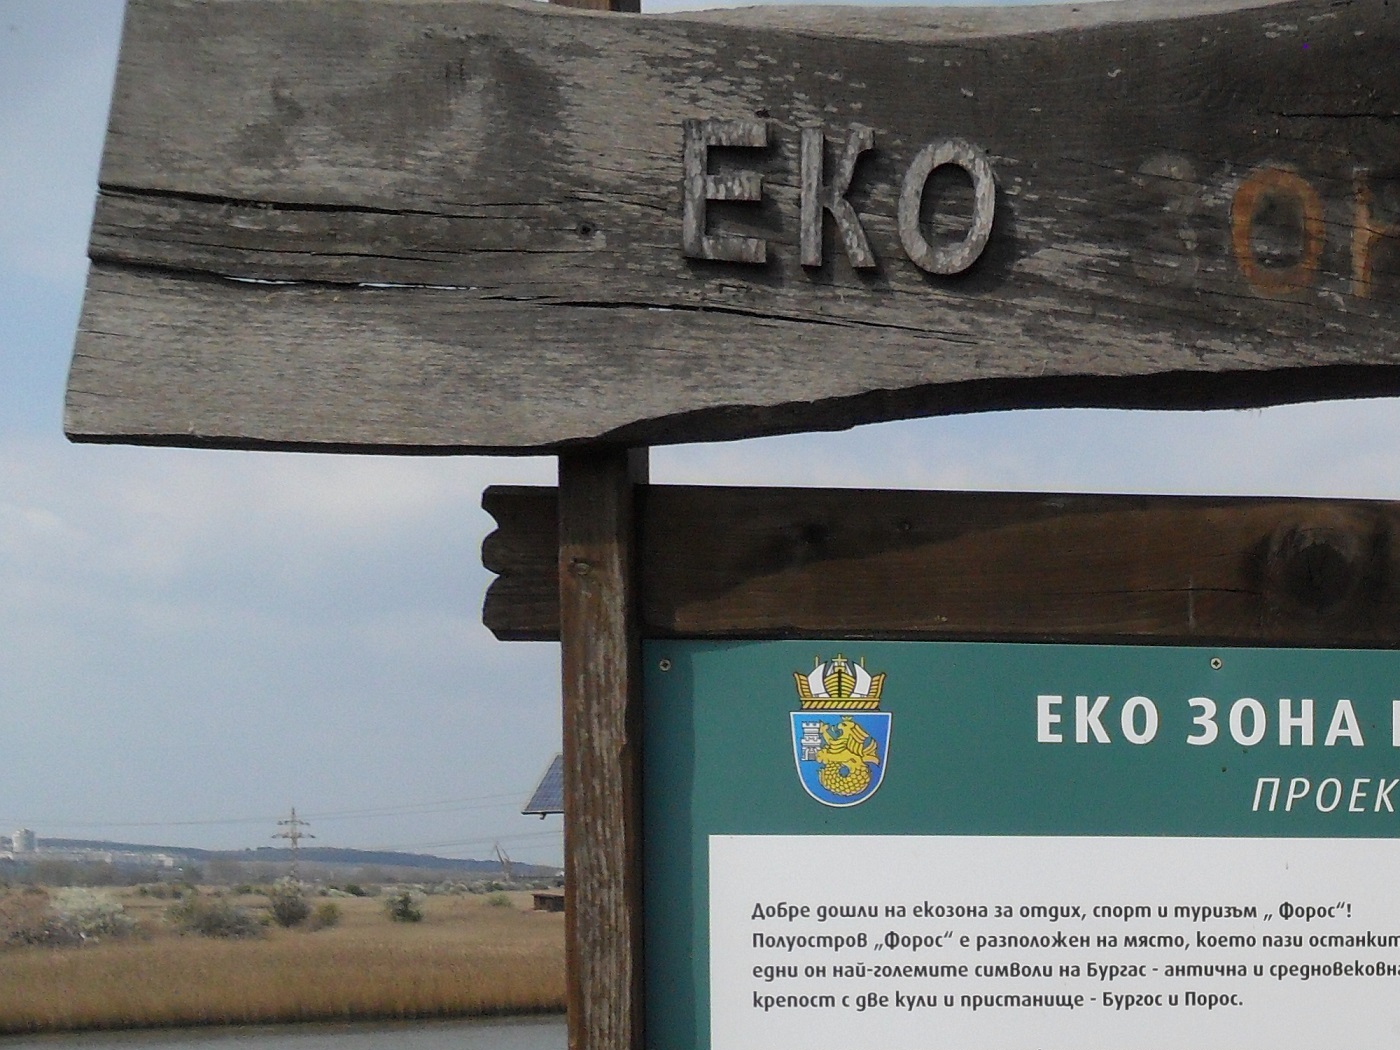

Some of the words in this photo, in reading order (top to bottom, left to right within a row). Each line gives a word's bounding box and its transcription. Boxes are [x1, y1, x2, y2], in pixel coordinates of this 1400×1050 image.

[683, 118, 995, 275] ЕКО
[1037, 695, 1158, 744] ЕКО
[1187, 697, 1364, 746] ЗОНА
[751, 901, 811, 923] Добре
[816, 905, 879, 923] дошли
[884, 905, 907, 918] на
[912, 900, 989, 918] екозона
[993, 905, 1013, 919] за
[1019, 905, 1087, 923] отдих,
[1092, 905, 1152, 923] спорт
[1157, 905, 1168, 919] и
[1173, 905, 1258, 923] туризъм
[752, 932, 868, 953] Полуостров
[959, 935, 971, 948] е
[976, 930, 1091, 952] разположен
[1096, 935, 1118, 948] на
[1123, 935, 1191, 951] място,
[1196, 930, 1257, 948] което
[1262, 935, 1303, 948] пази
